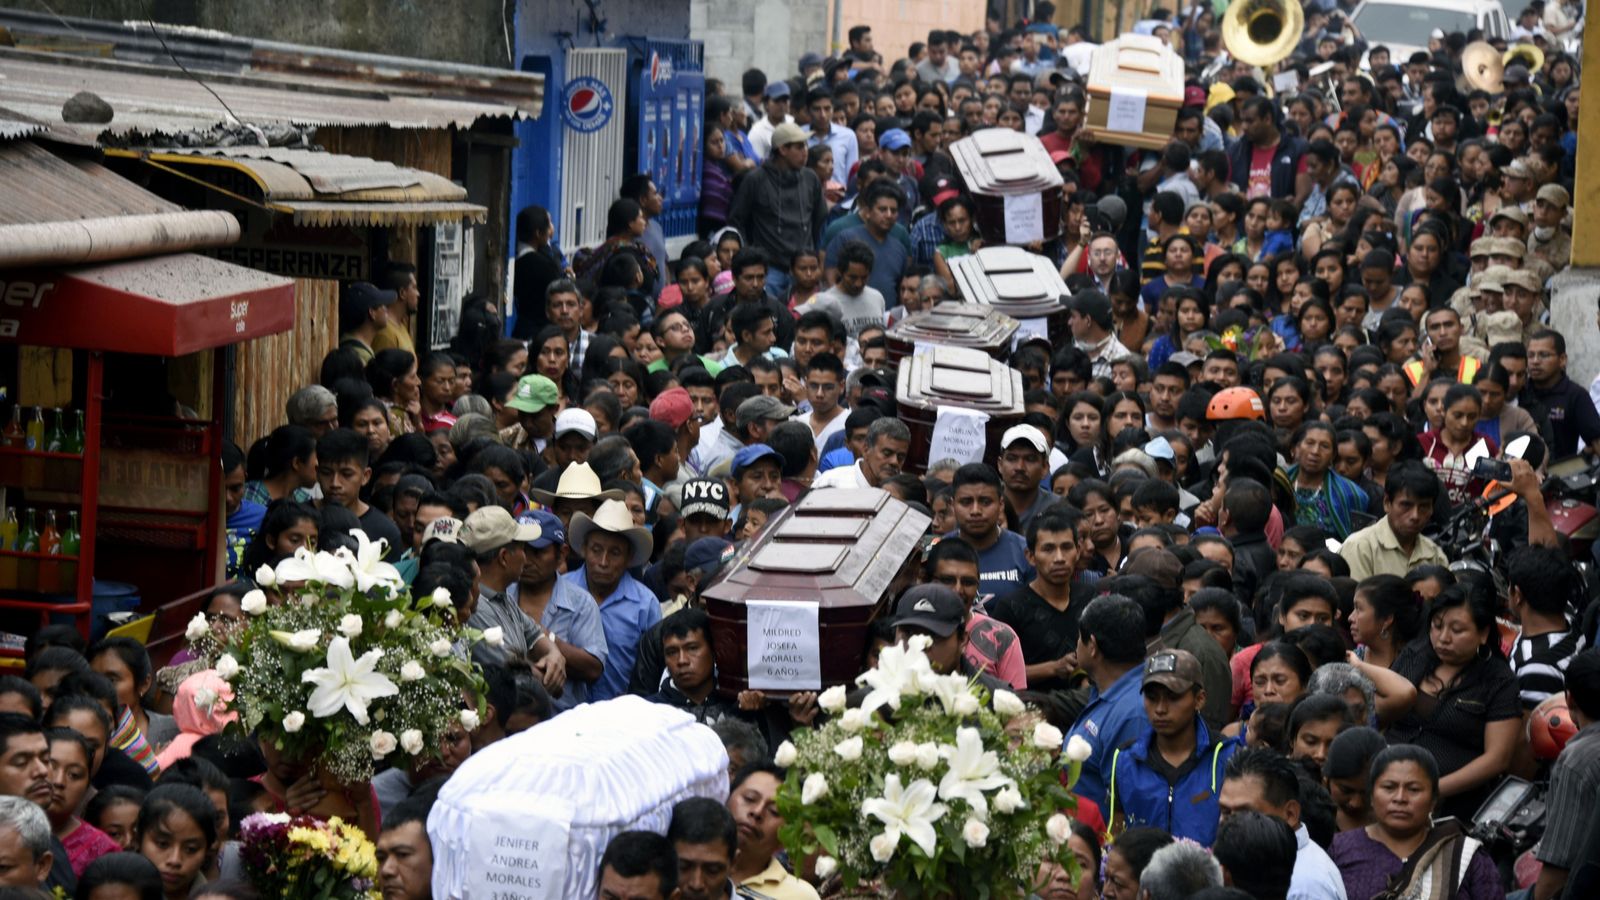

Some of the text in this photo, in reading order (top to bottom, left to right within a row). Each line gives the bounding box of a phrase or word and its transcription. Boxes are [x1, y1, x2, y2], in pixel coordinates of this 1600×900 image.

[943, 436, 975, 447] MORALES
[684, 480, 724, 500] NYC
[762, 628, 802, 637] MILDRED
[766, 641, 798, 651] JOSEFA
[761, 654, 804, 664] MORALES
[767, 666, 799, 677] 6 AÑOS
[494, 835, 540, 852] JENIFER
[490, 853, 539, 870] ANDREA
[485, 871, 542, 889] MORALES
